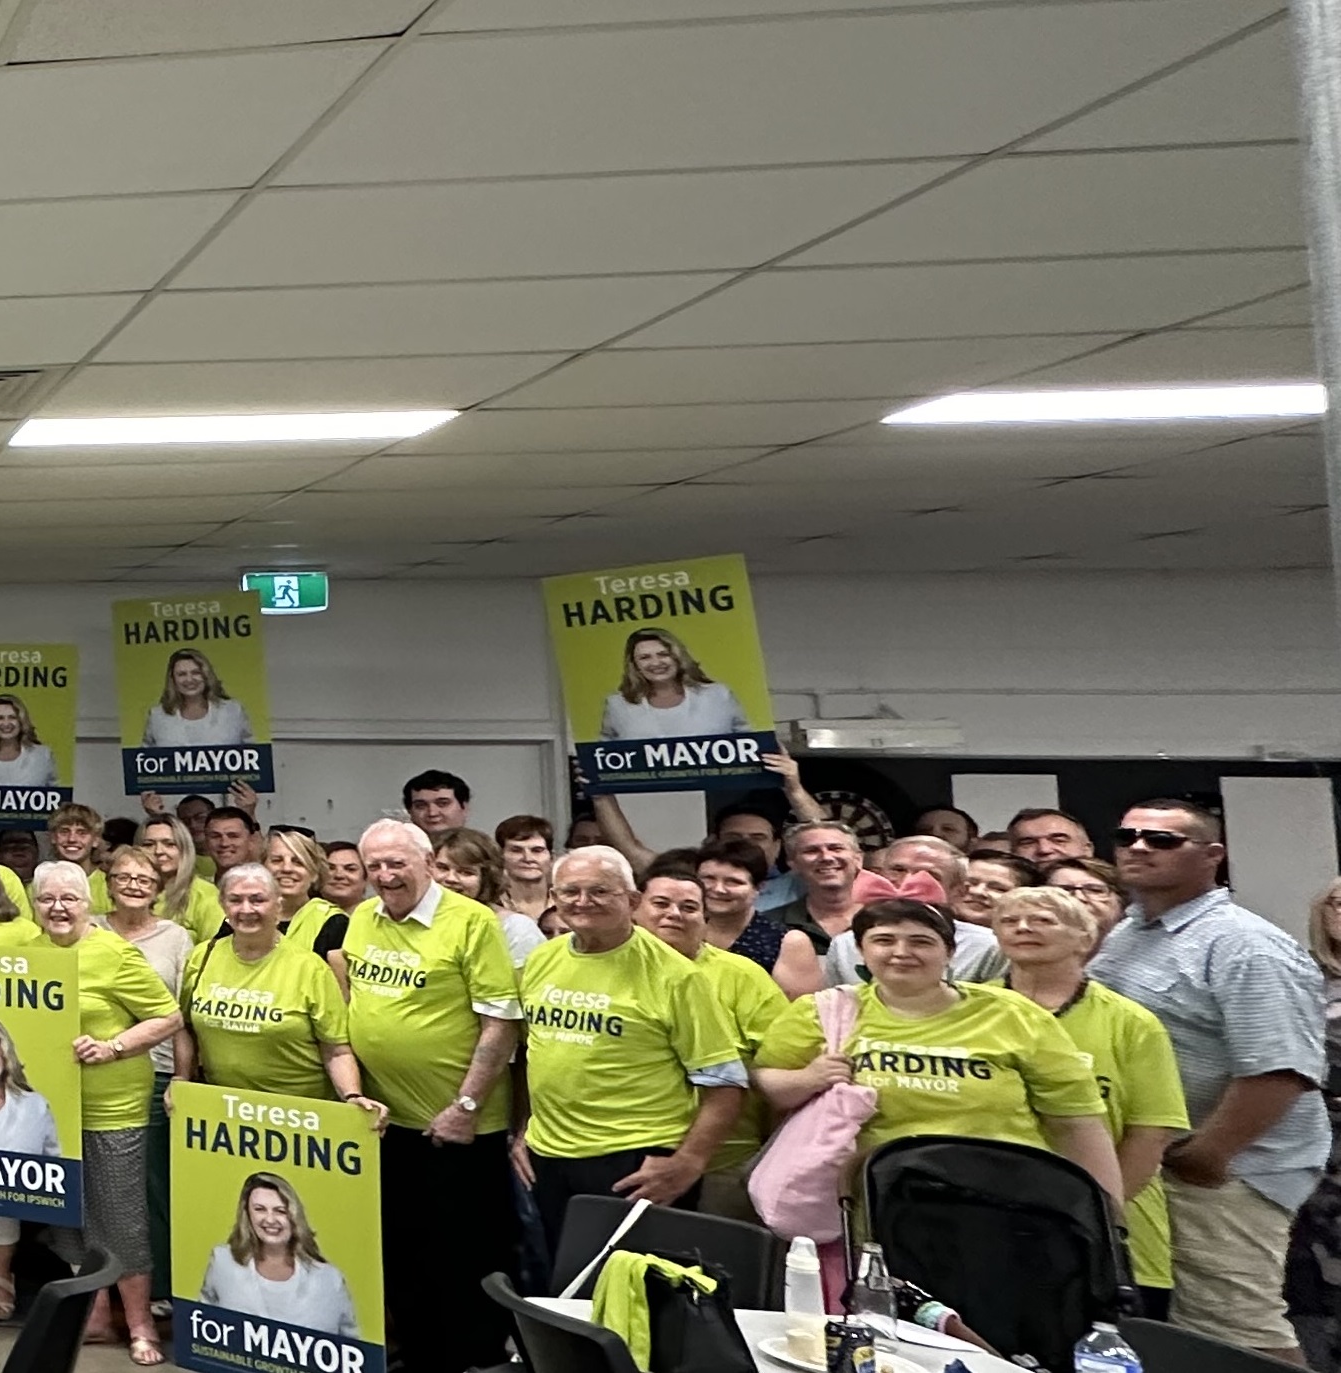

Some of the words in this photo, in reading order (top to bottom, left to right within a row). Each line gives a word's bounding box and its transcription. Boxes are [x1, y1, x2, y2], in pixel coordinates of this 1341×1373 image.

[594, 571, 690, 595] Teresa
[150, 600, 221, 618] Teresa
[562, 585, 734, 627] HARDING
[124, 615, 251, 645] HARDING
[135, 753, 168, 774] for
[174, 749, 260, 773] MAYOR
[594, 747, 637, 770] for
[643, 738, 760, 768] MAYOR
[365, 944, 421, 968] Teresa
[209, 982, 274, 1005] Teresa
[540, 983, 612, 1011] Teresa
[191, 996, 283, 1023] HARDING
[525, 1004, 623, 1037] HARDING
[856, 1053, 992, 1080] ARDING
[896, 1075, 960, 1093] MAYOR
[222, 1094, 320, 1131] Teresa
[186, 1117, 362, 1176] HARDING
[7, 1191, 26, 1203] FOR
[26, 1194, 66, 1208] IPSWICH
[190, 1309, 234, 1347] for
[243, 1320, 365, 1373] MAYOR
